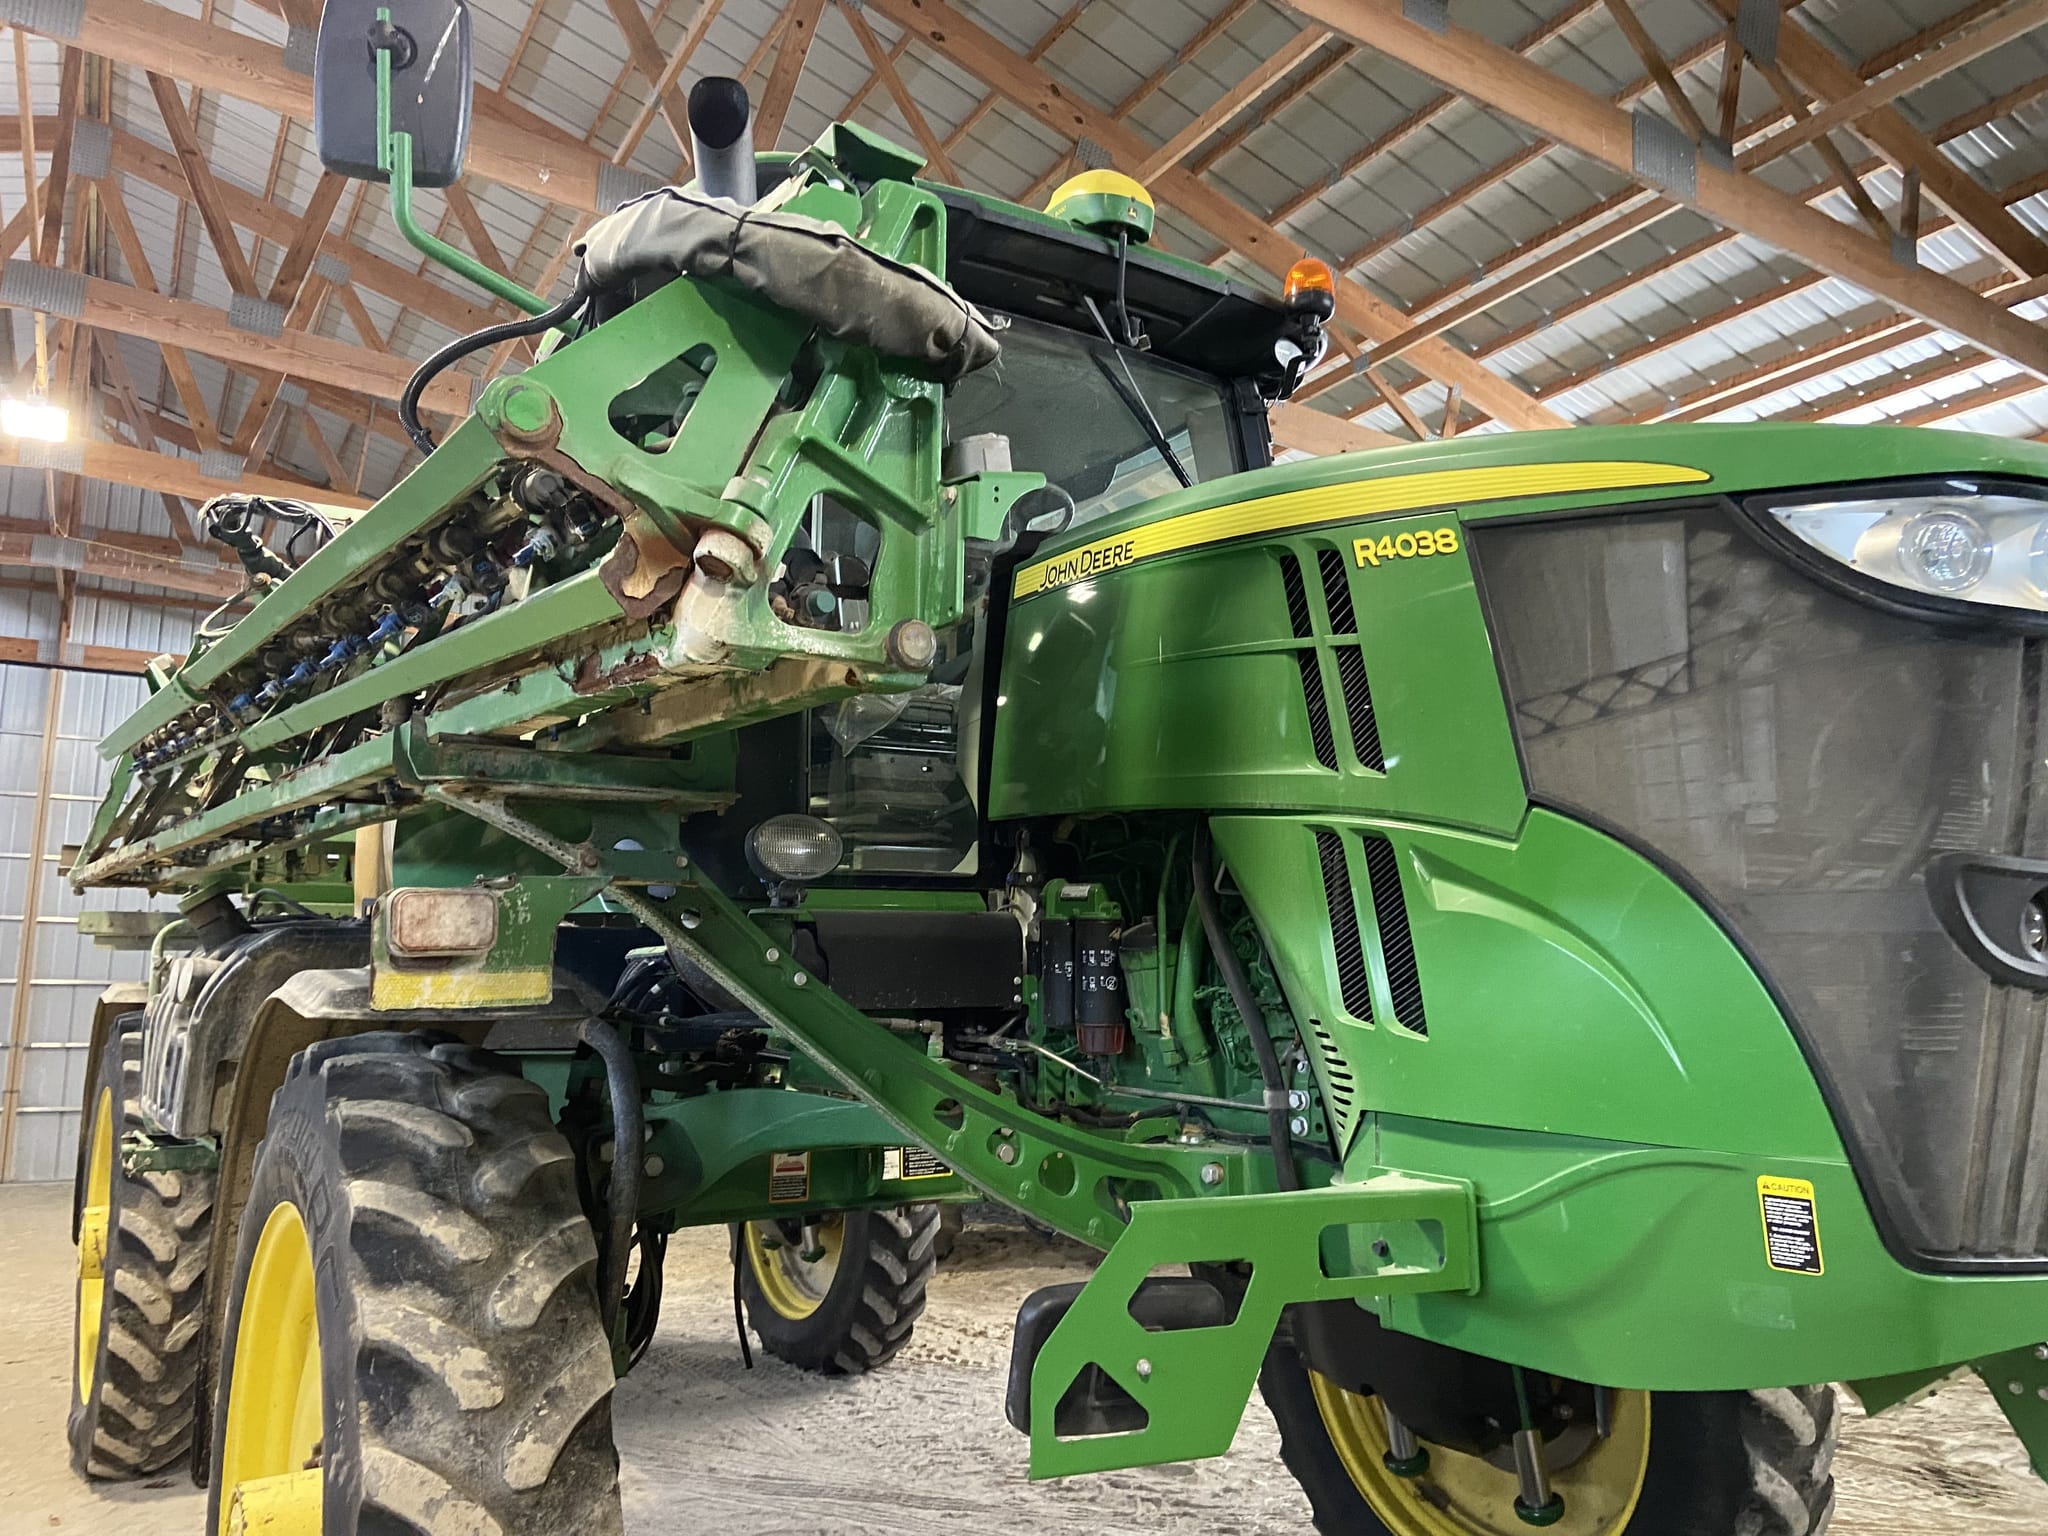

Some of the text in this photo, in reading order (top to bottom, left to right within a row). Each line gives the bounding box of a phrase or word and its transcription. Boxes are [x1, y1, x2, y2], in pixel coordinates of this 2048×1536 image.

[1039, 541, 1135, 589] JOHN DEERE
[1352, 528, 1459, 569] R4038
[1771, 1183, 1809, 1194] CAUTION
